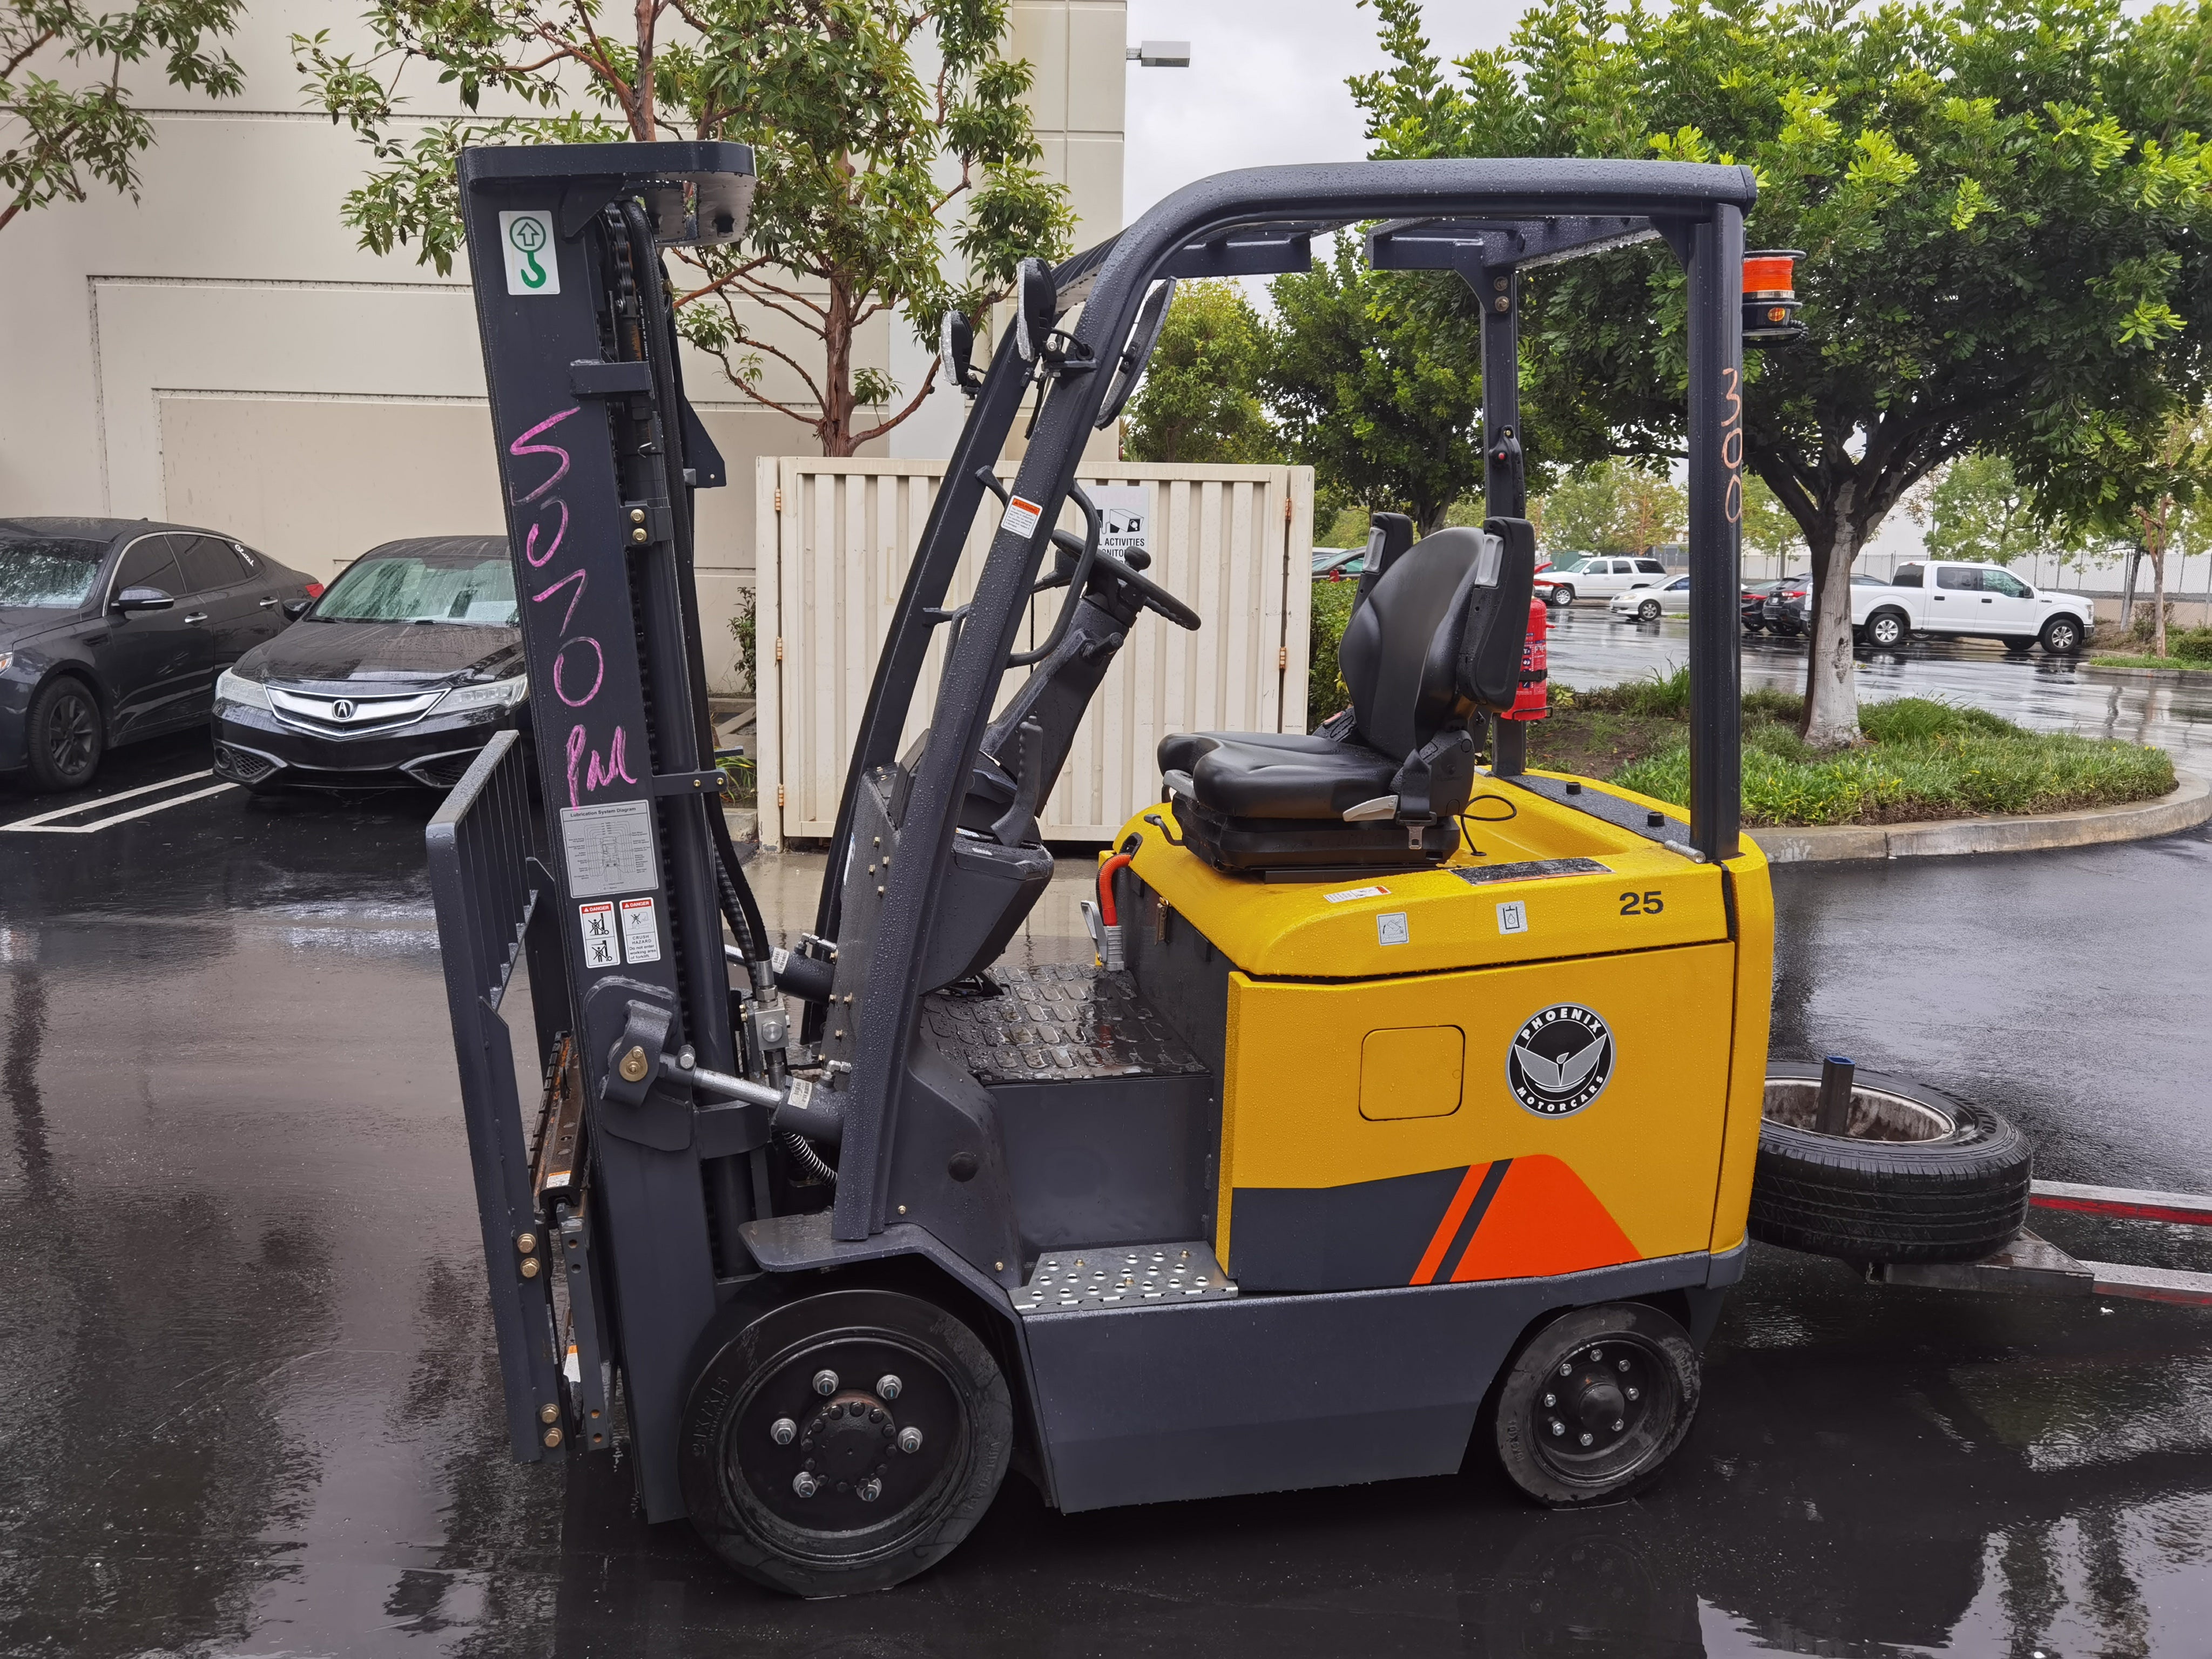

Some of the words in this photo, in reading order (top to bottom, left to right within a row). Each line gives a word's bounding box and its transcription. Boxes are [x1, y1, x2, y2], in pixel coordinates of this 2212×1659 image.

[1721, 367, 1743, 523] 300
[1105, 538, 1144, 547] ACTIVITIES
[1620, 891, 1664, 915] 25
[1521, 1008, 1602, 1040] PHOENIX
[1517, 1076, 1603, 1112] MOTORCARS
